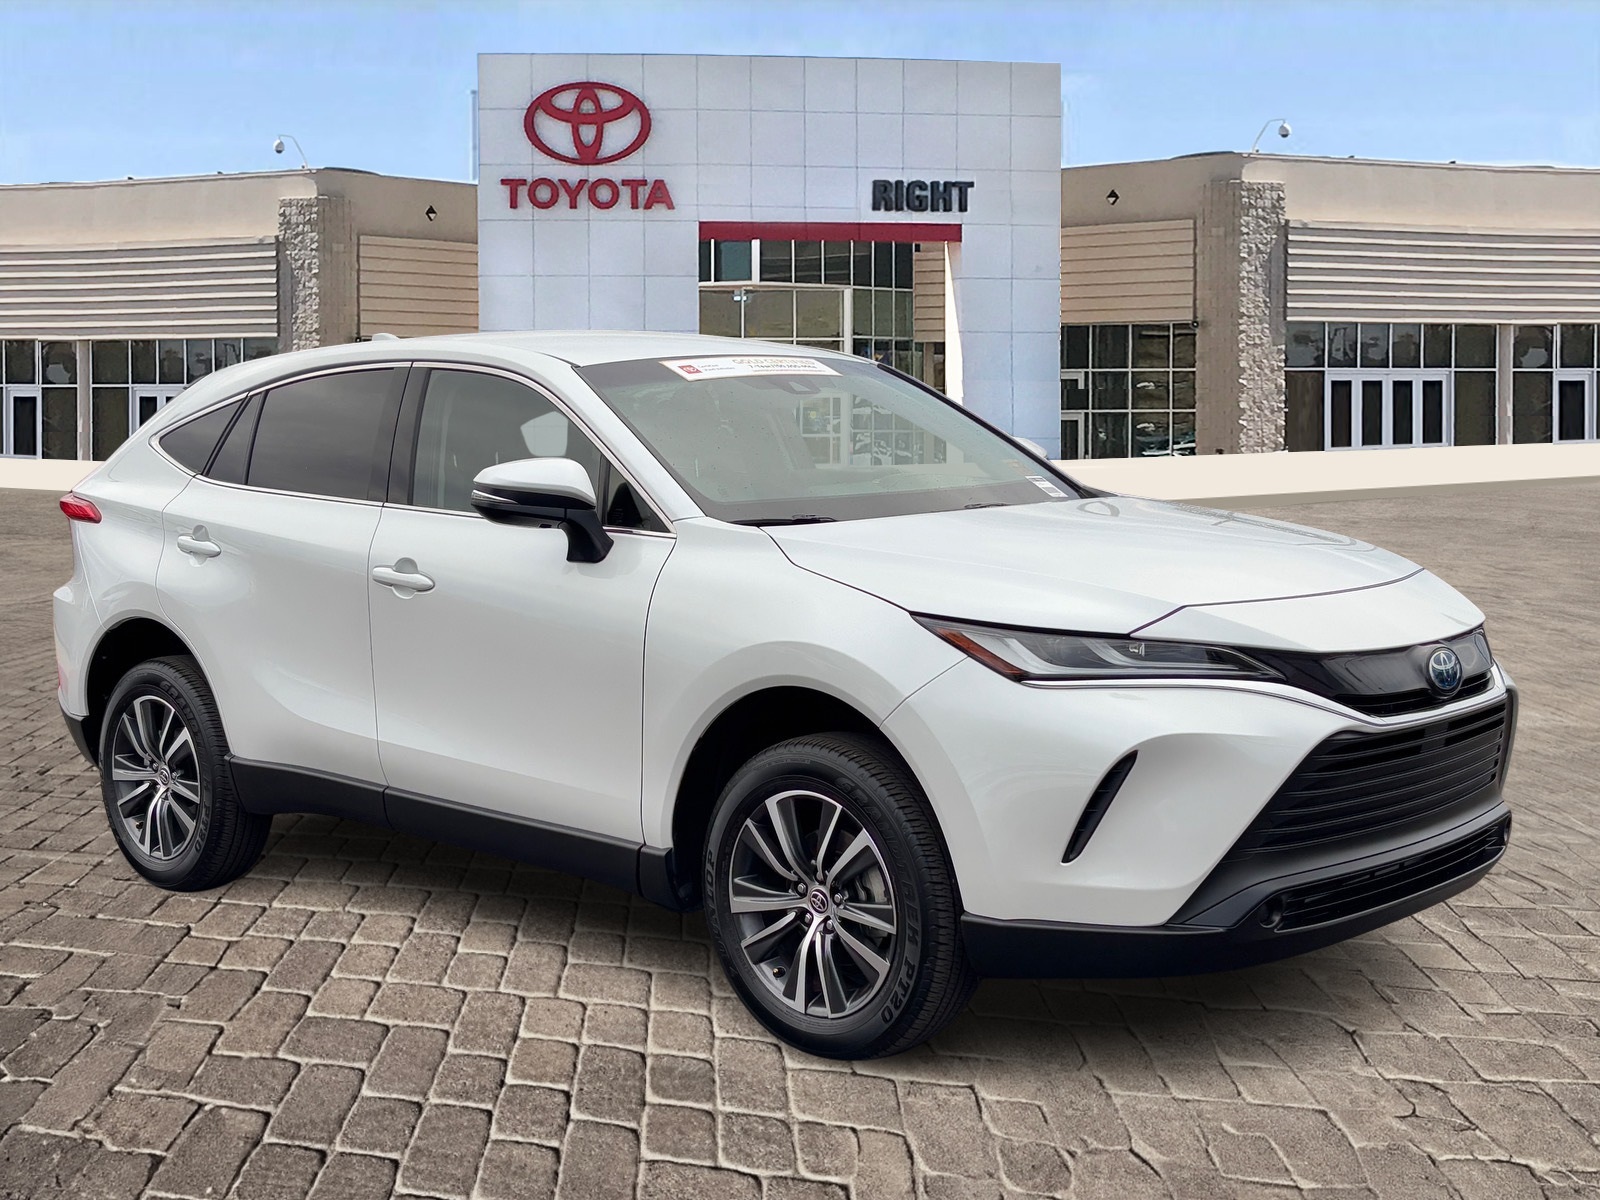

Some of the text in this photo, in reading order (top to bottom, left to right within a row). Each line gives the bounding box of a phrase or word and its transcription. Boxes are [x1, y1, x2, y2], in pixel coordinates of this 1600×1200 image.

[500, 177, 675, 210] TOYOTA
[871, 179, 975, 212] RIGHT
[880, 956, 916, 1024] PT20
